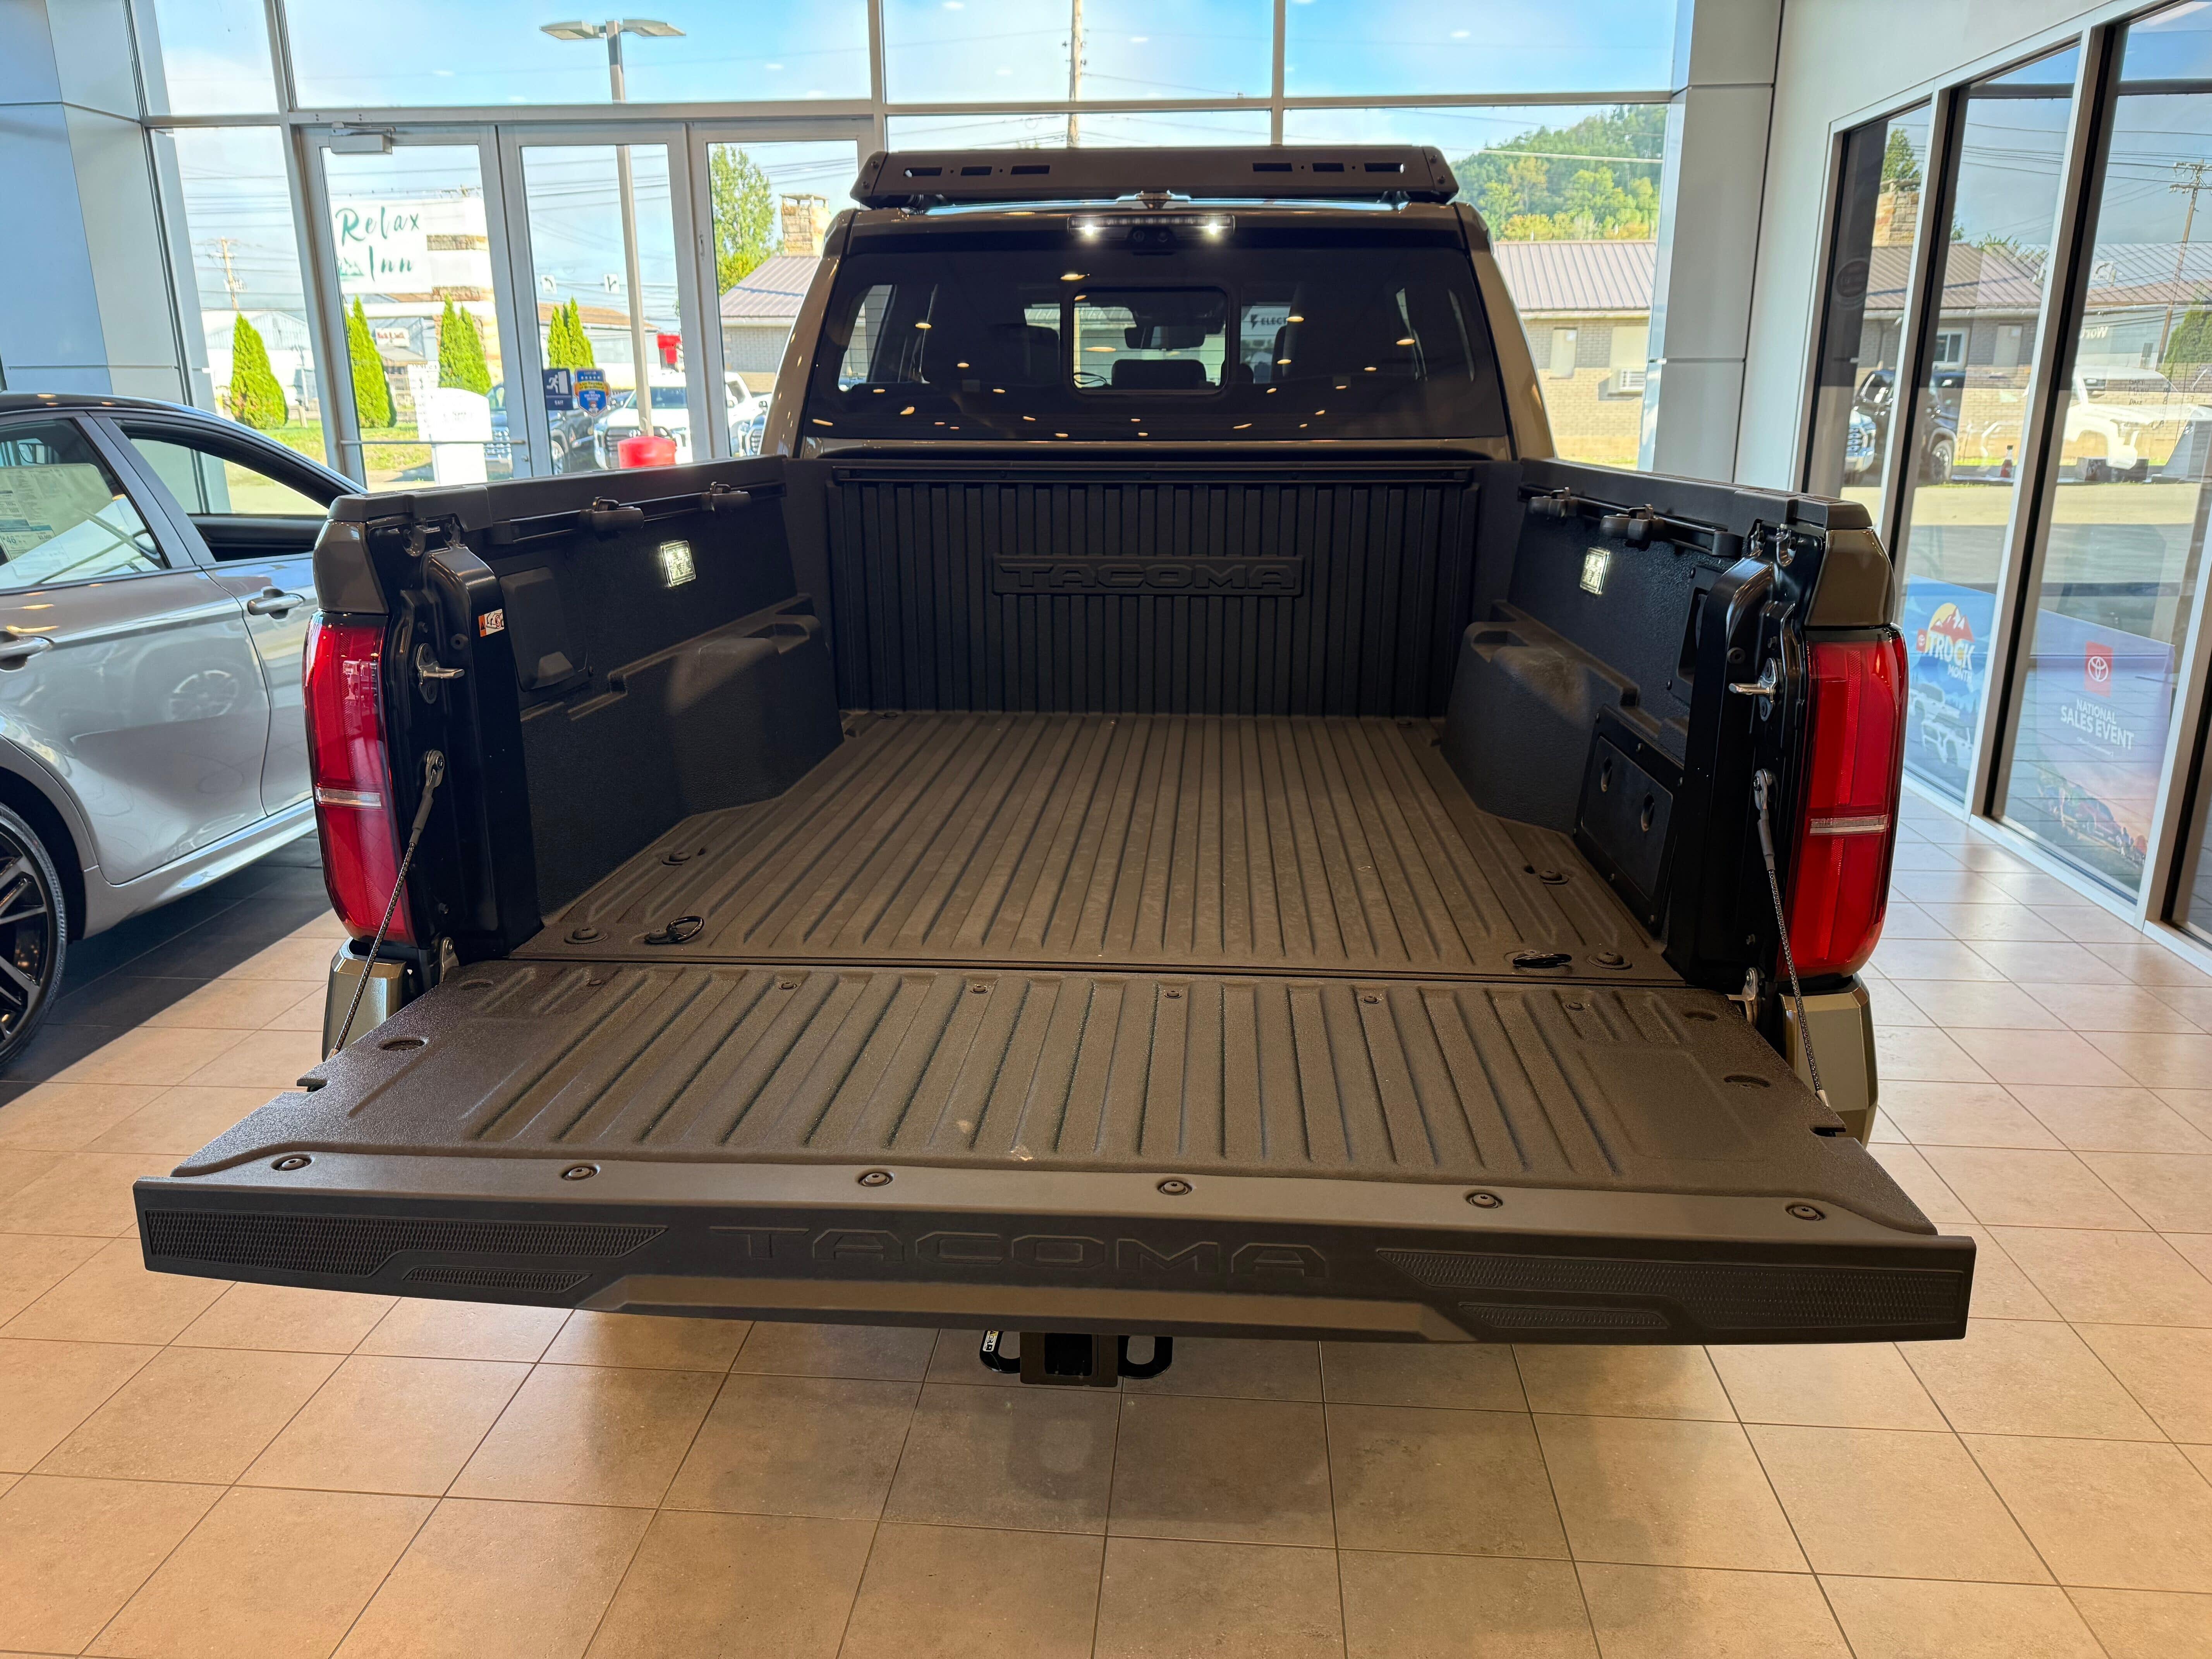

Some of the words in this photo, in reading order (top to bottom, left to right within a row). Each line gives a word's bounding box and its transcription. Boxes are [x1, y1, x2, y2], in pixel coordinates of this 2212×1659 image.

[335, 206, 419, 247] Relax
[369, 245, 412, 282] Inn
[1000, 563, 1296, 589] TACOMA
[1928, 631, 1975, 670] TRUCK
[1948, 664, 1972, 683] MONTH
[2061, 705, 2094, 733] SALES
[2095, 718, 2135, 750] EVENT
[2076, 698, 2117, 725] NATIONAL
[709, 1226, 1327, 1278] TACOMA
